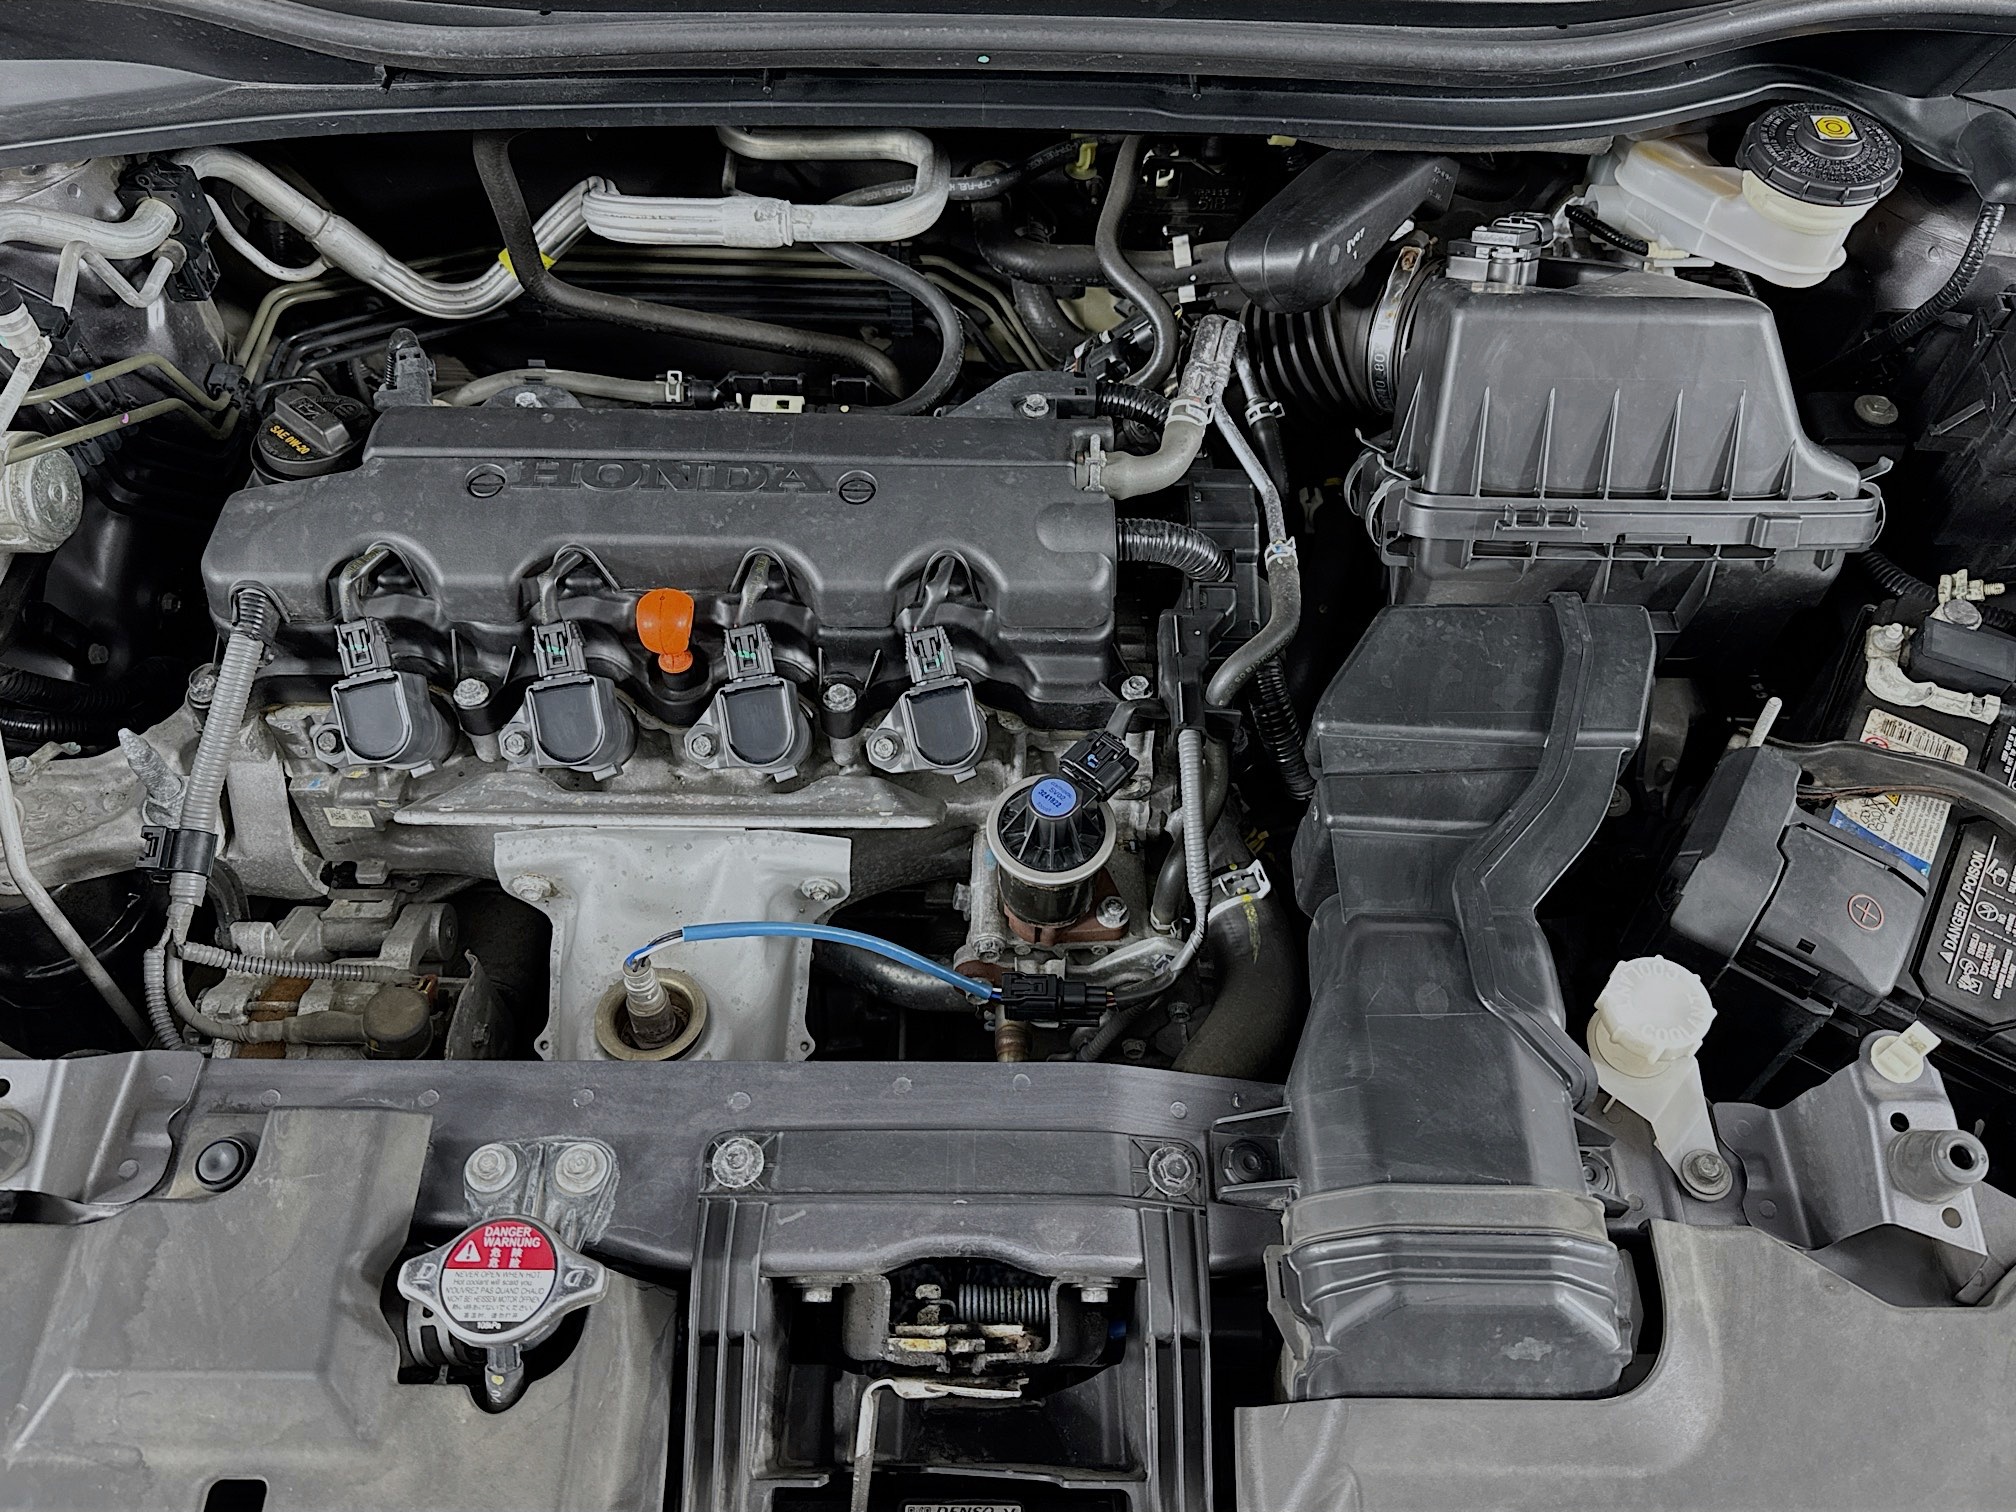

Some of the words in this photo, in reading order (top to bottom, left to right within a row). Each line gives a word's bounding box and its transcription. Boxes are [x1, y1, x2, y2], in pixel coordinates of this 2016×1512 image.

[270, 425, 291, 440] SAE
[284, 435, 311, 455] 0W-20
[510, 460, 832, 494] HONDA
[1966, 931, 1981, 955] SHIELD
[1974, 941, 1987, 959] EYES
[1978, 942, 1997, 976] EXPLOSIVE
[1987, 958, 2001, 980] GASES
[483, 1236, 541, 1248] WARNUNG
[484, 1226, 532, 1237] DANGER
[495, 1287, 520, 1295] QUAND
